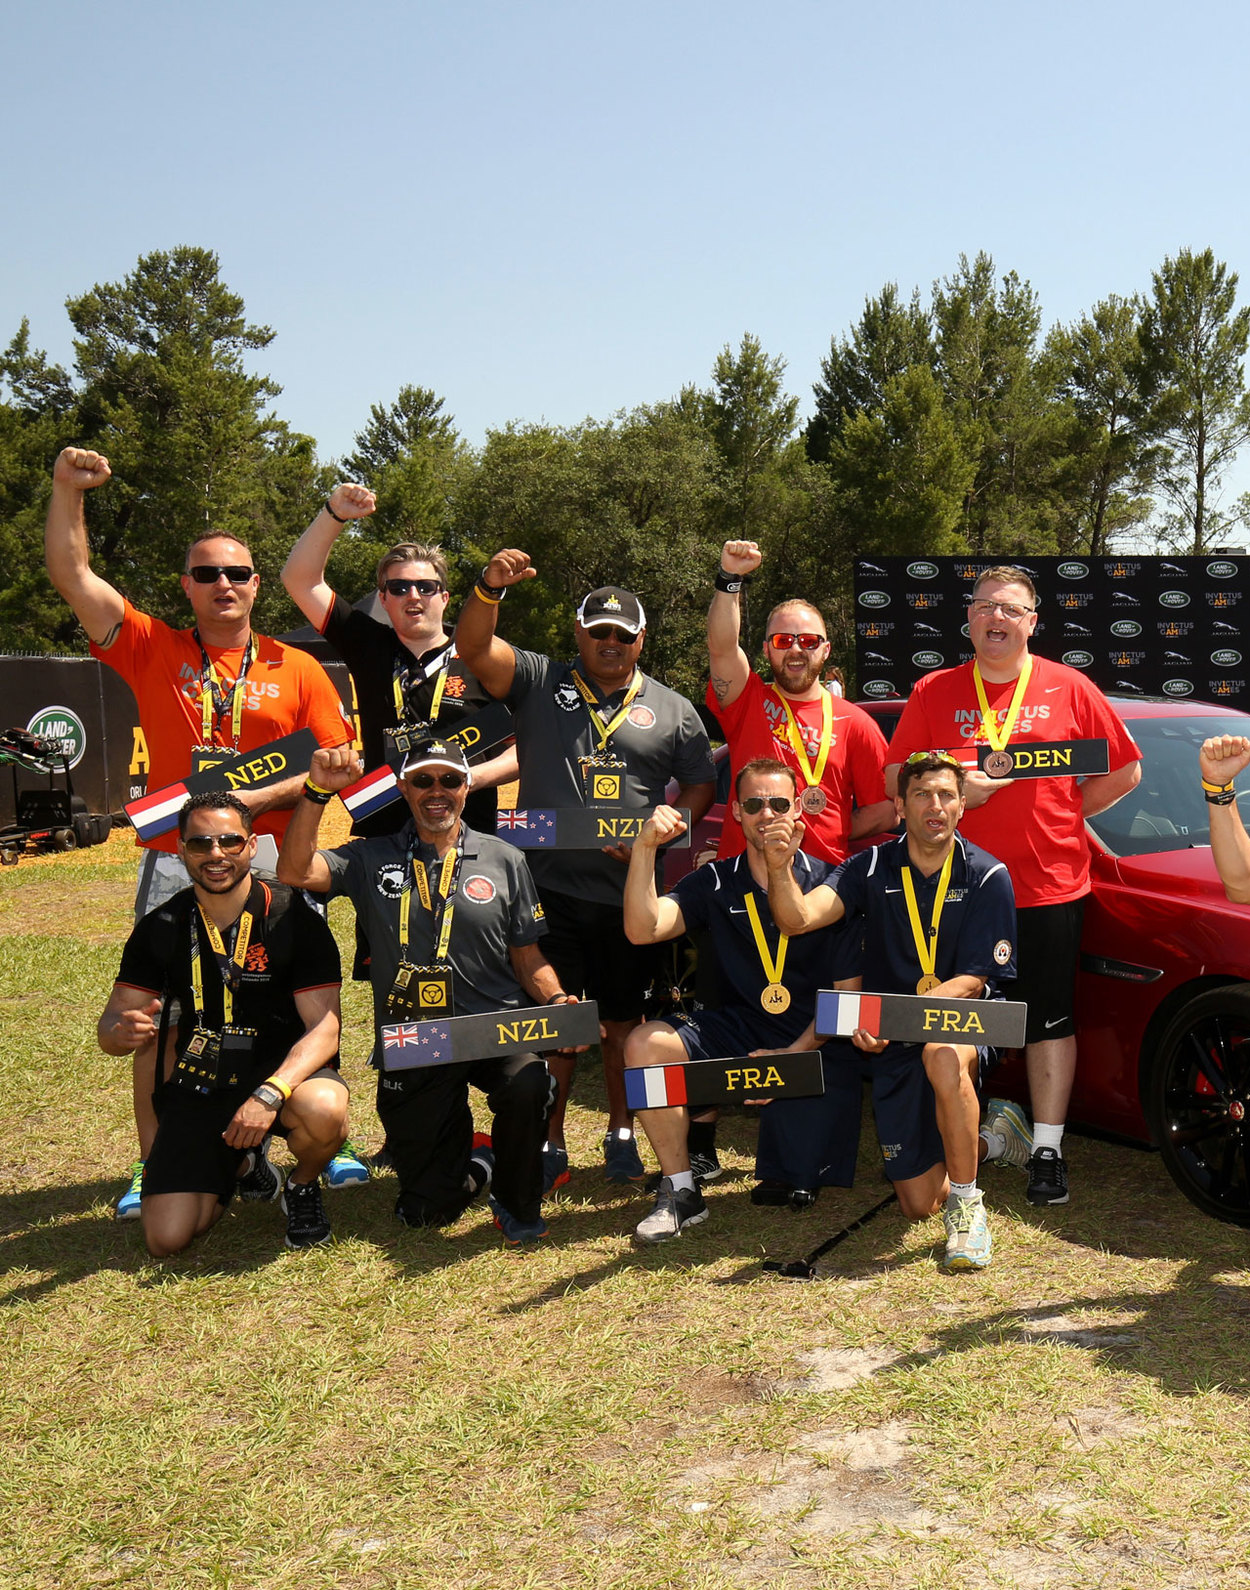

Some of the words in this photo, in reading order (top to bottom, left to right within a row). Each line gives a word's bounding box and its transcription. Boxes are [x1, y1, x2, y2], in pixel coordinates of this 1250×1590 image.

[1205, 592, 1242, 600] INVICTUS
[1156, 622, 1194, 630] INVICTUS
[1208, 680, 1246, 688] INVICTUS
[446, 726, 481, 750] ED
[224, 752, 287, 790] NED
[1013, 748, 1073, 769] DEN
[416, 863, 429, 905] COMPETITOR
[236, 916, 250, 961] COMPETITOR
[497, 1018, 558, 1044] NZL
[922, 1008, 985, 1034] FRA
[725, 1066, 785, 1091] FRA
